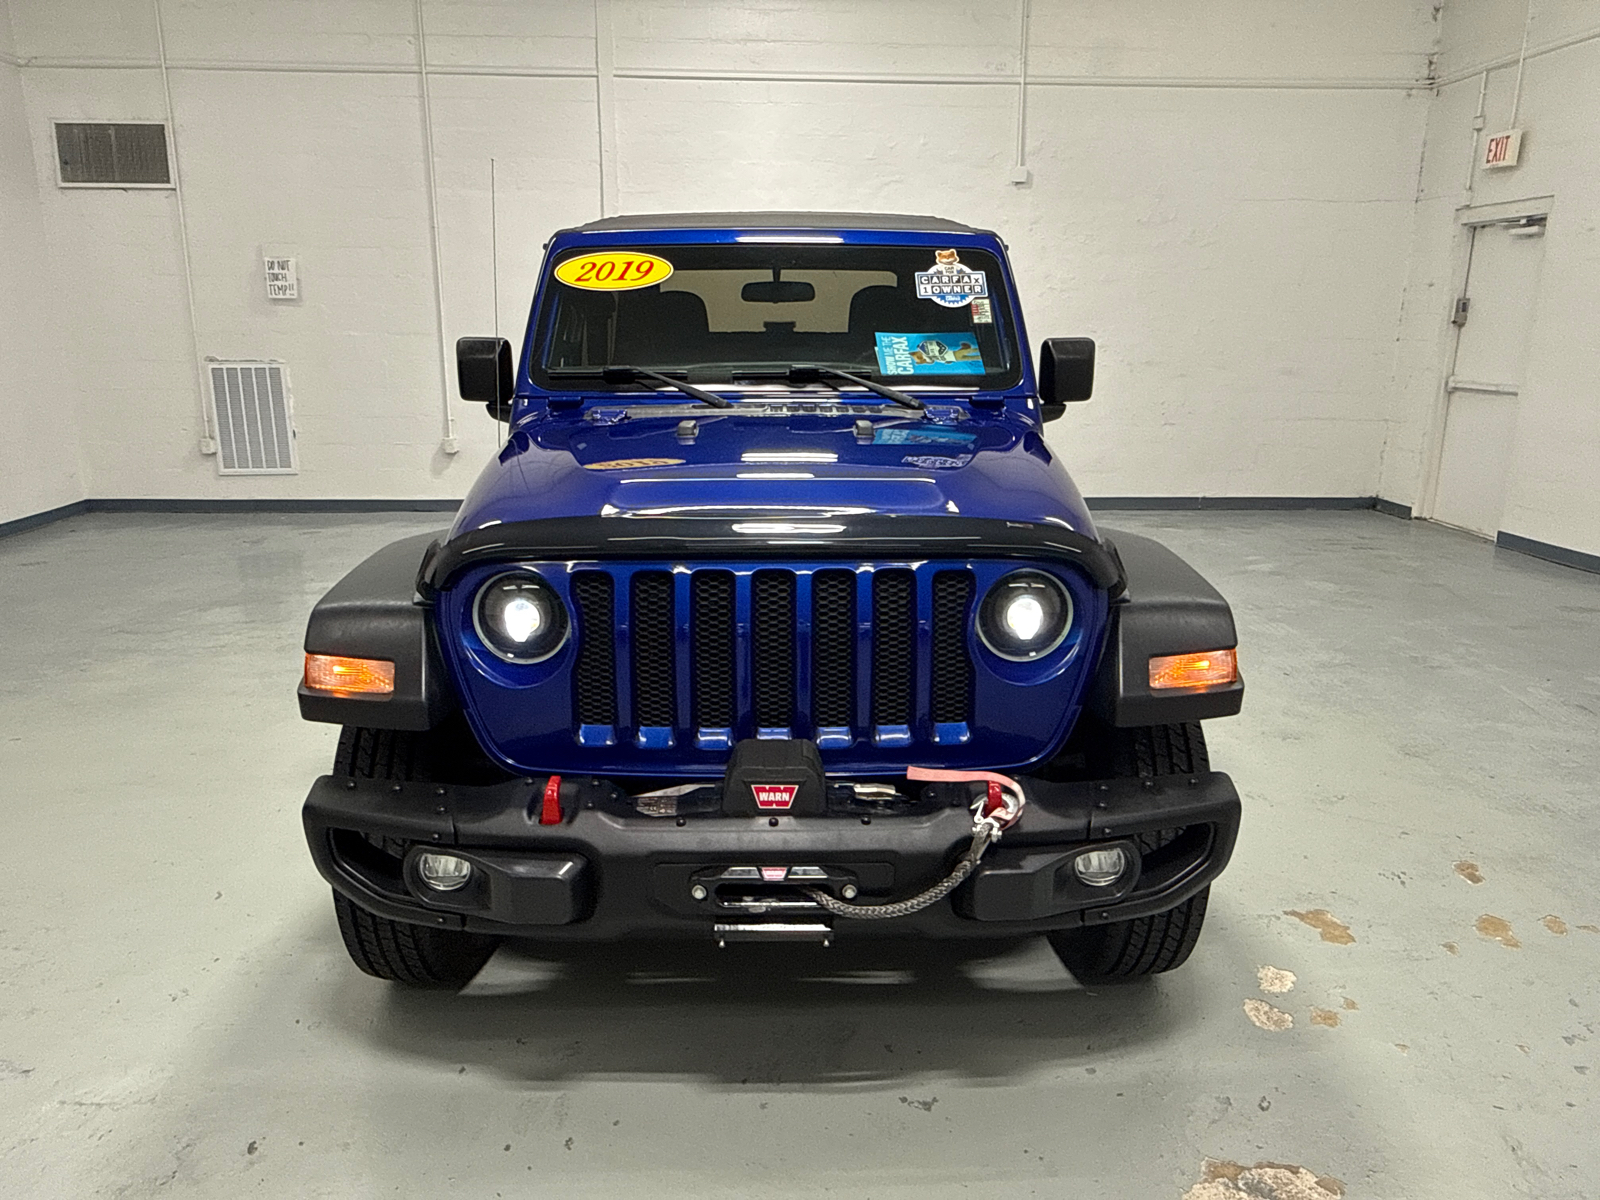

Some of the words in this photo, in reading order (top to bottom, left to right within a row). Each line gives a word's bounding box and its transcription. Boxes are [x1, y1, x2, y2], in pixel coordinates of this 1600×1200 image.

[1486, 135, 1511, 164] EXIT
[267, 260, 275, 271] DO
[277, 260, 290, 271] NOT
[574, 260, 655, 282] 2019
[921, 275, 980, 284] CARFAX
[932, 285, 982, 294] OWNER
[881, 336, 892, 346] THE
[892, 336, 914, 375] CARFAX
[887, 356, 898, 375] SHOW
[759, 791, 790, 802] WARN
